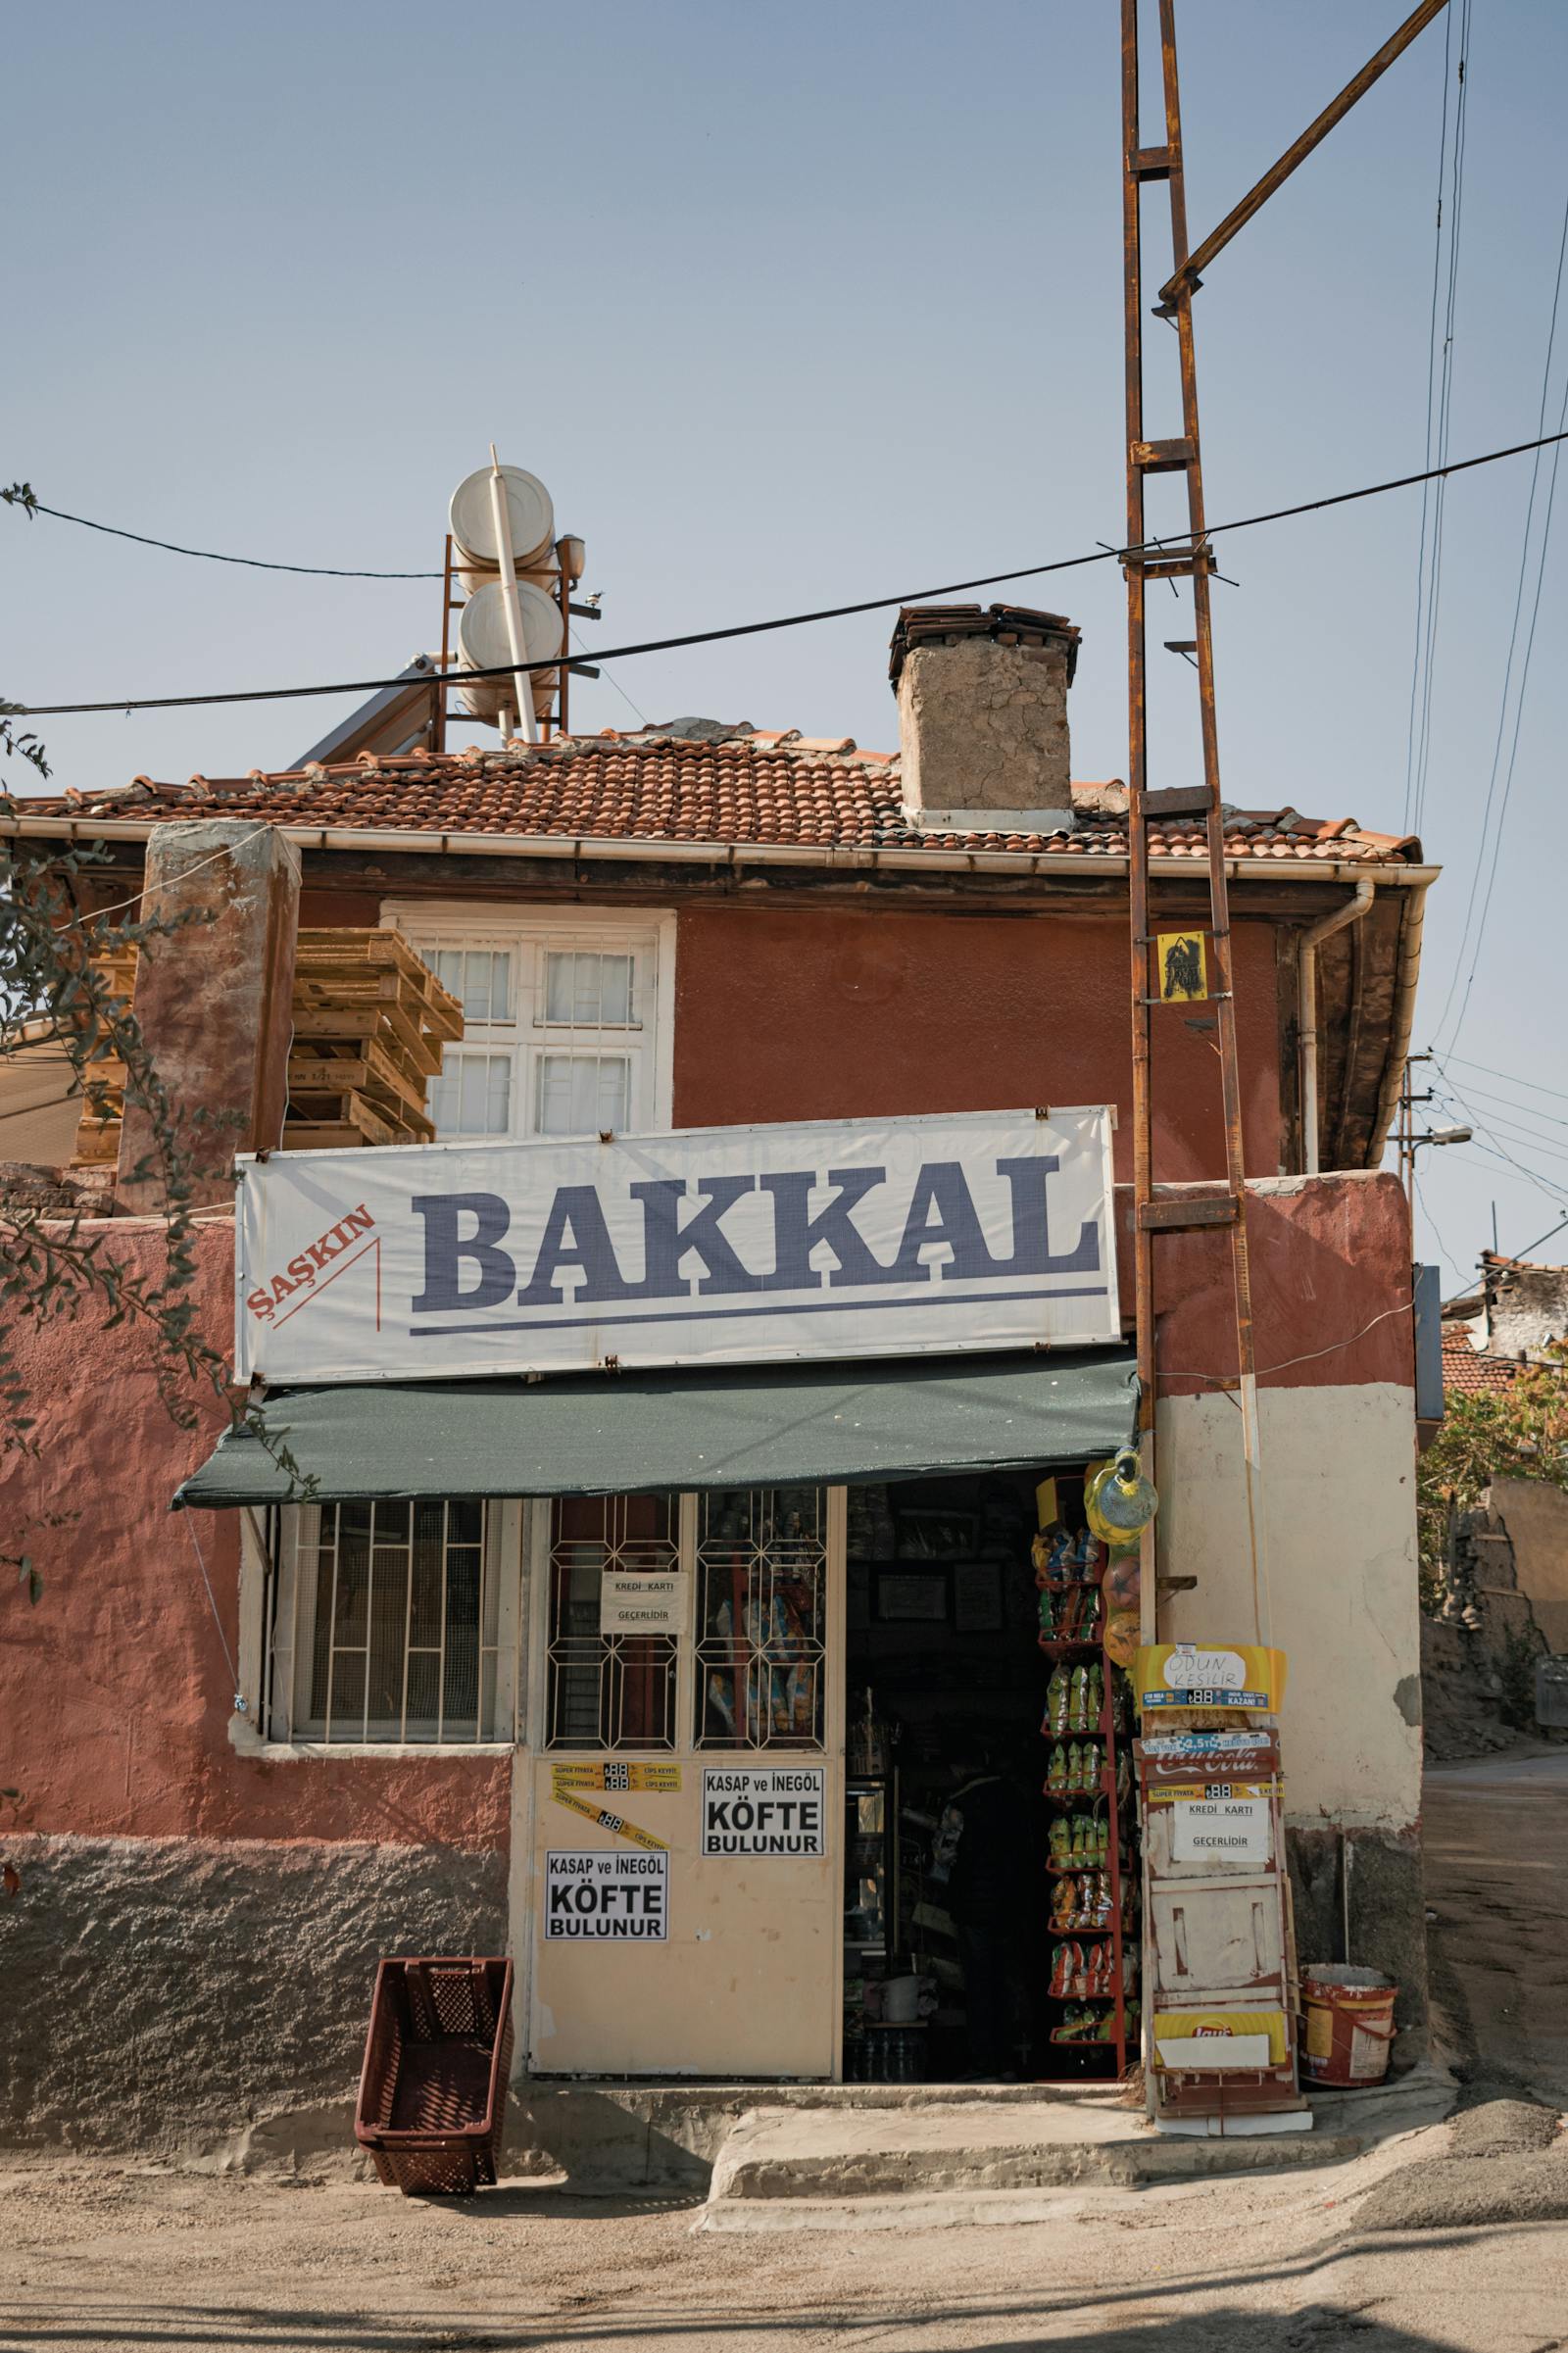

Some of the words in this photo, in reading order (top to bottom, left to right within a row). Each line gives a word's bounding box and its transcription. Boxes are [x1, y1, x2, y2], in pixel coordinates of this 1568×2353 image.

[411, 1154, 1102, 1313] BAKKAL
[246, 1202, 376, 1322] ŞAŞKIN
[614, 1581, 642, 1591] KREDİ
[647, 1582, 674, 1591] KARTI
[617, 1609, 668, 1621] GEÇERLİDİR
[1169, 1655, 1226, 1672] ODUN
[707, 1775, 750, 1791] KASAP
[754, 1779, 768, 1791] ve
[772, 1771, 820, 1791] İNEGÖL
[708, 1795, 818, 1831] KÖFTE
[1189, 1803, 1217, 1814] KREDİ
[1225, 1805, 1253, 1815] KARTI
[708, 1835, 818, 1852] BULUNUR
[1193, 1835, 1248, 1847] GEÇERLİDİR
[550, 1857, 594, 1875] KASAP
[598, 1862, 612, 1875] ve
[615, 1853, 664, 1875] İNEGÖL
[551, 1878, 662, 1914] KÖFTE
[550, 1918, 662, 1936] BULUNUR
